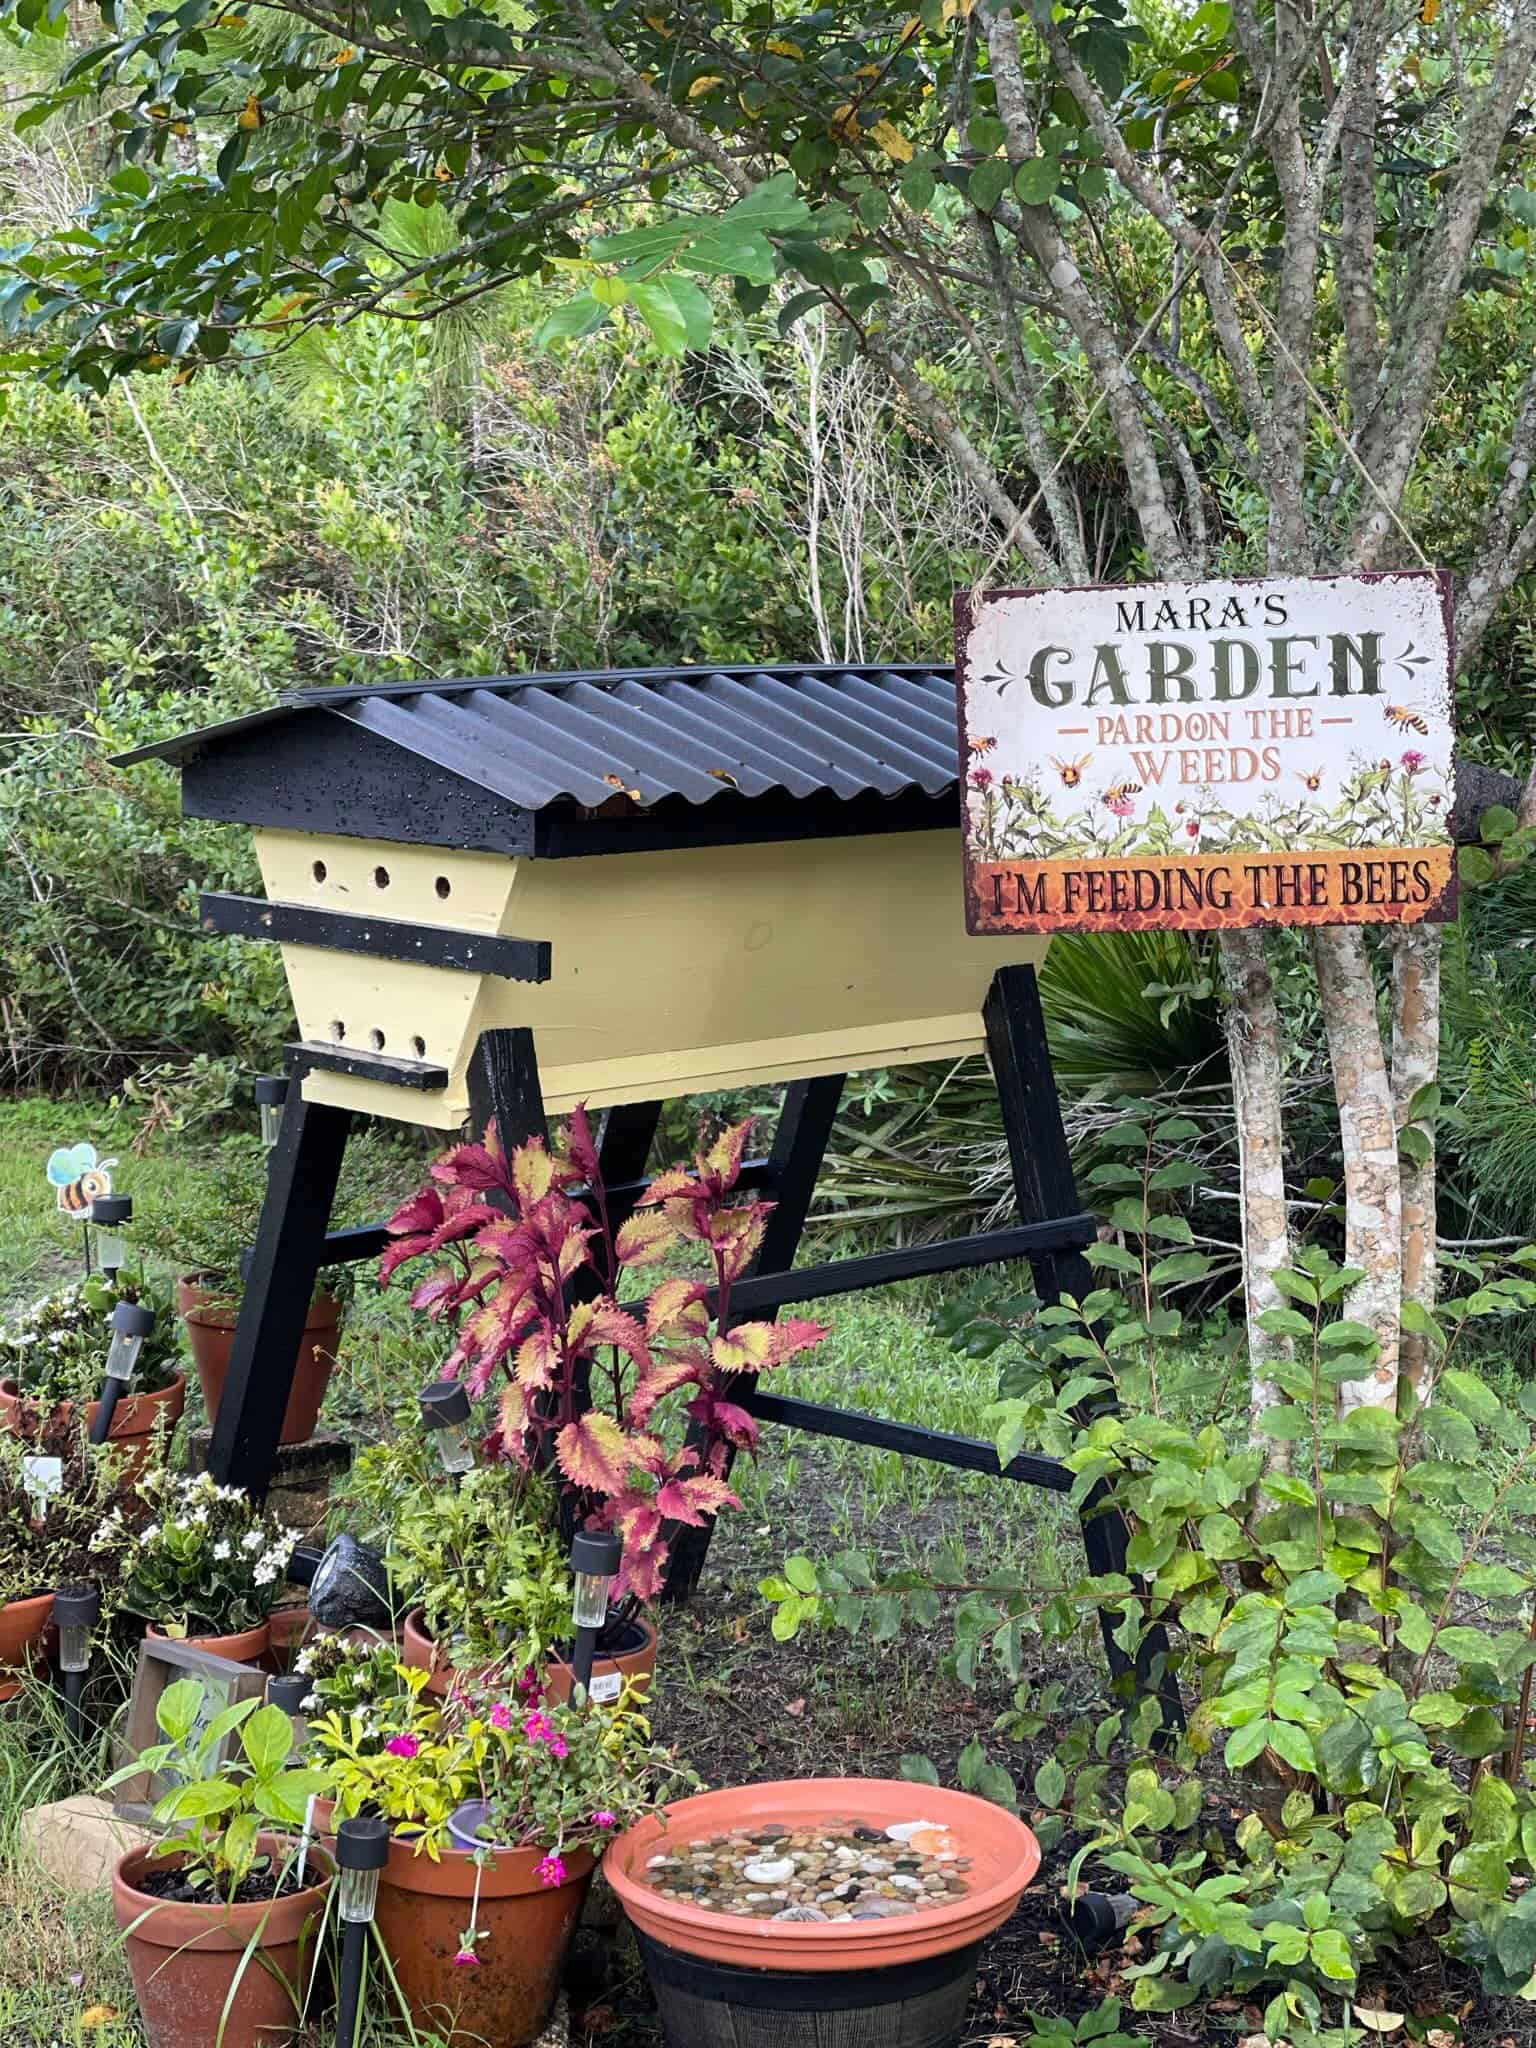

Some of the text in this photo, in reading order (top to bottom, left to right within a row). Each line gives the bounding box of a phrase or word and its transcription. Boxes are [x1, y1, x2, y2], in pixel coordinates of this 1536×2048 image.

[1115, 593, 1288, 633] MARA'S
[1024, 630, 1387, 709] GARDEN
[1096, 708, 1314, 746] PARDON THE
[1129, 746, 1282, 786] WEEDS
[990, 860, 1432, 917] I'M FEEDING THE BEES
